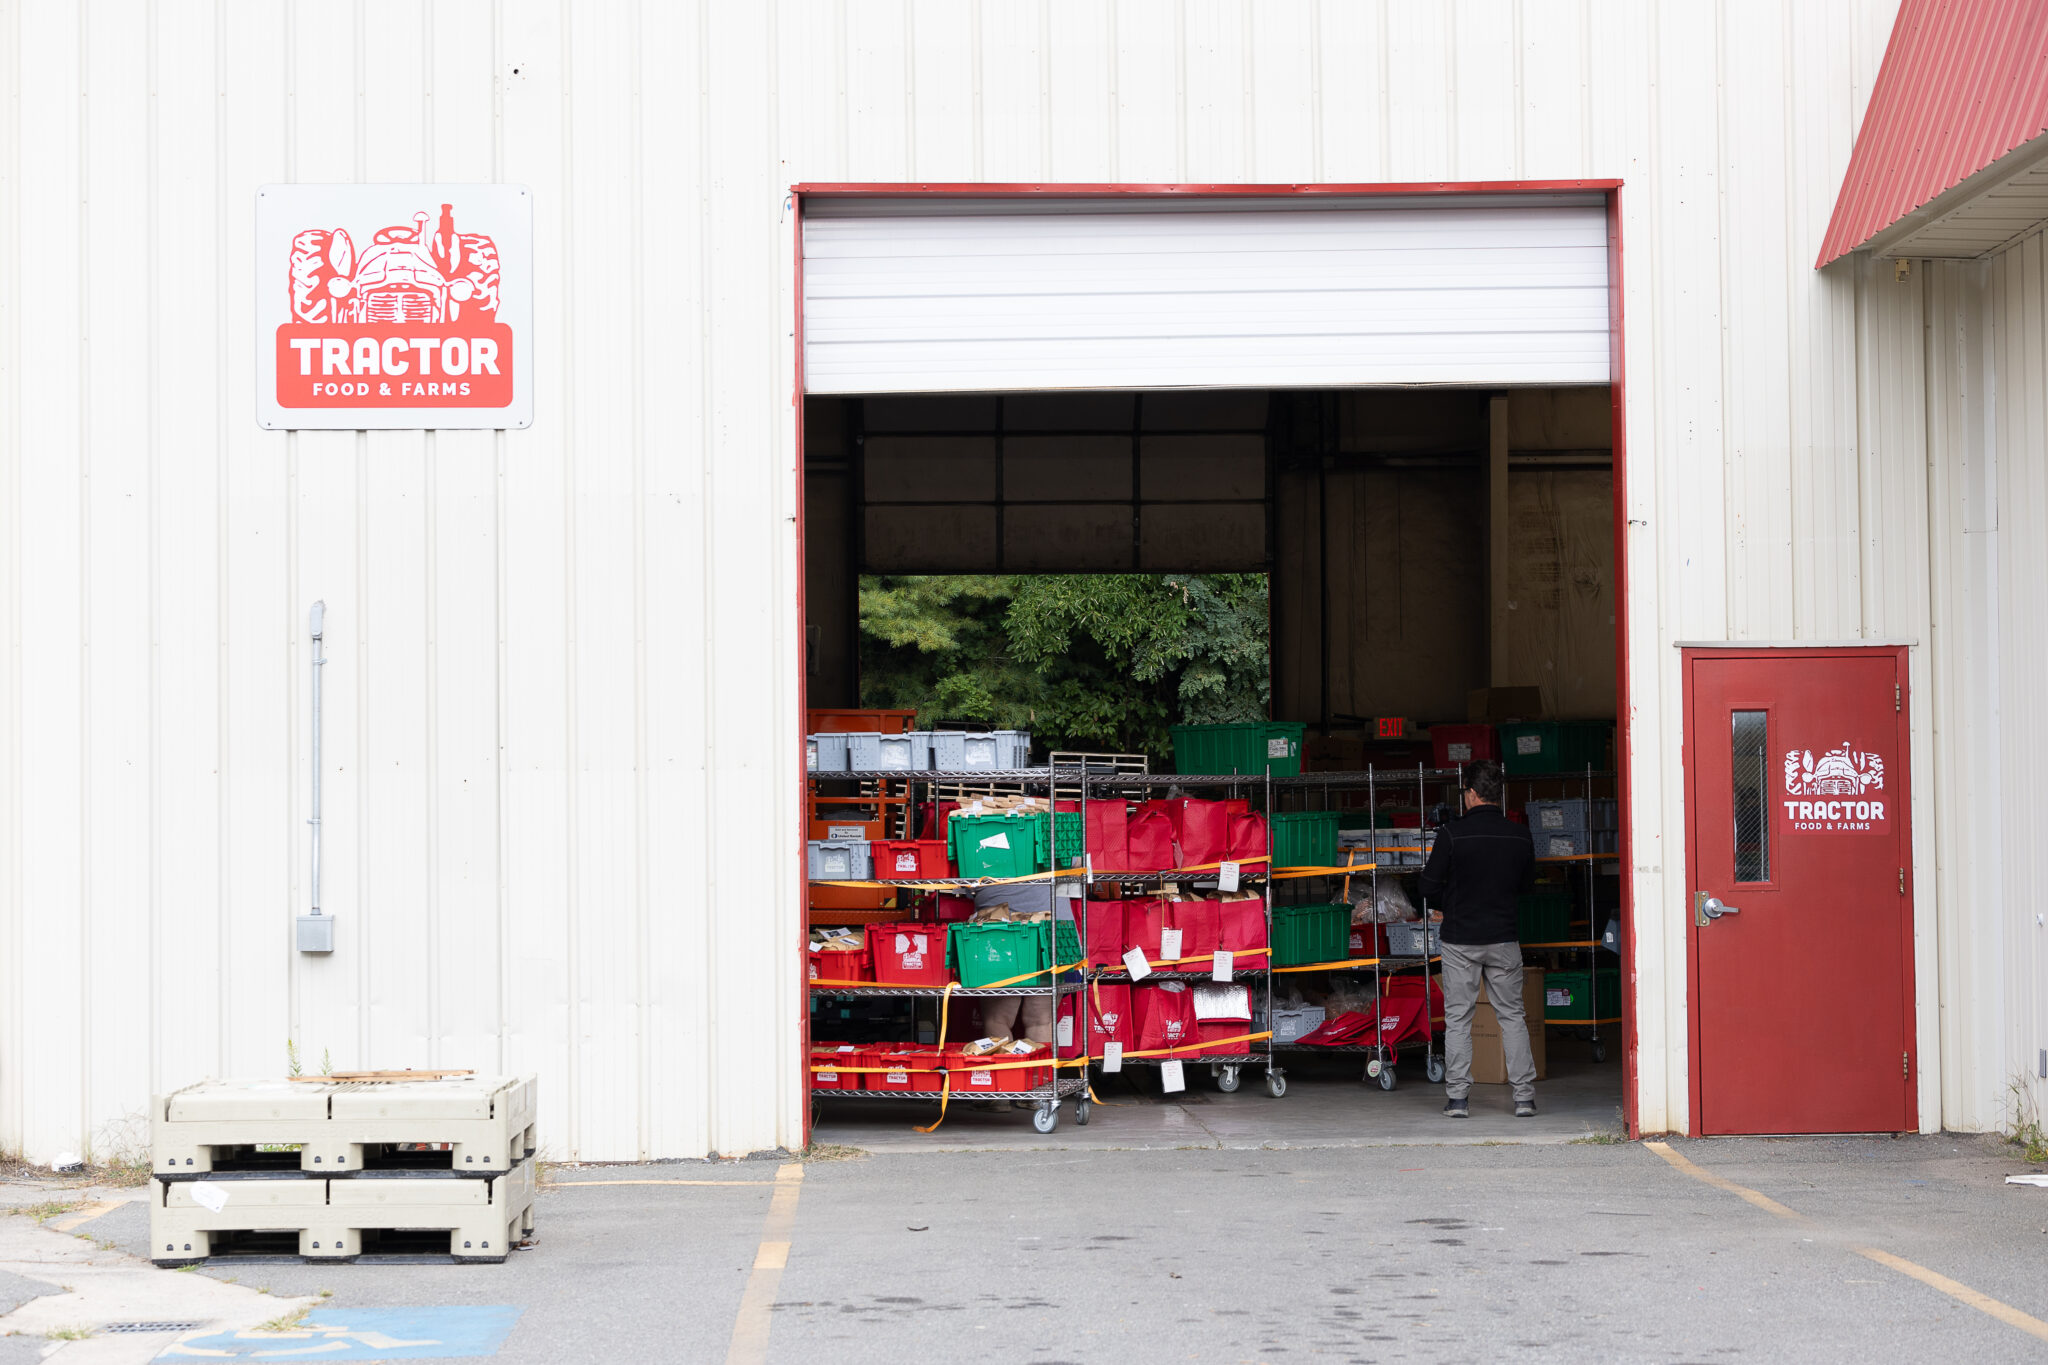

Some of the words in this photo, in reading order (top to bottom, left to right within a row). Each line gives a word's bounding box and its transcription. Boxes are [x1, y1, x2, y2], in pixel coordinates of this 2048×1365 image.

[290, 337, 501, 376] TRACTOR
[313, 382, 370, 396] FOOD
[379, 382, 392, 396] &
[402, 382, 471, 396] FARMS
[1379, 717, 1404, 736] EXIT
[1783, 800, 1885, 820] TRACTOR
[1794, 822, 1822, 830] FOOD
[1826, 822, 1833, 830] &
[1837, 822, 1870, 830] FARMS
